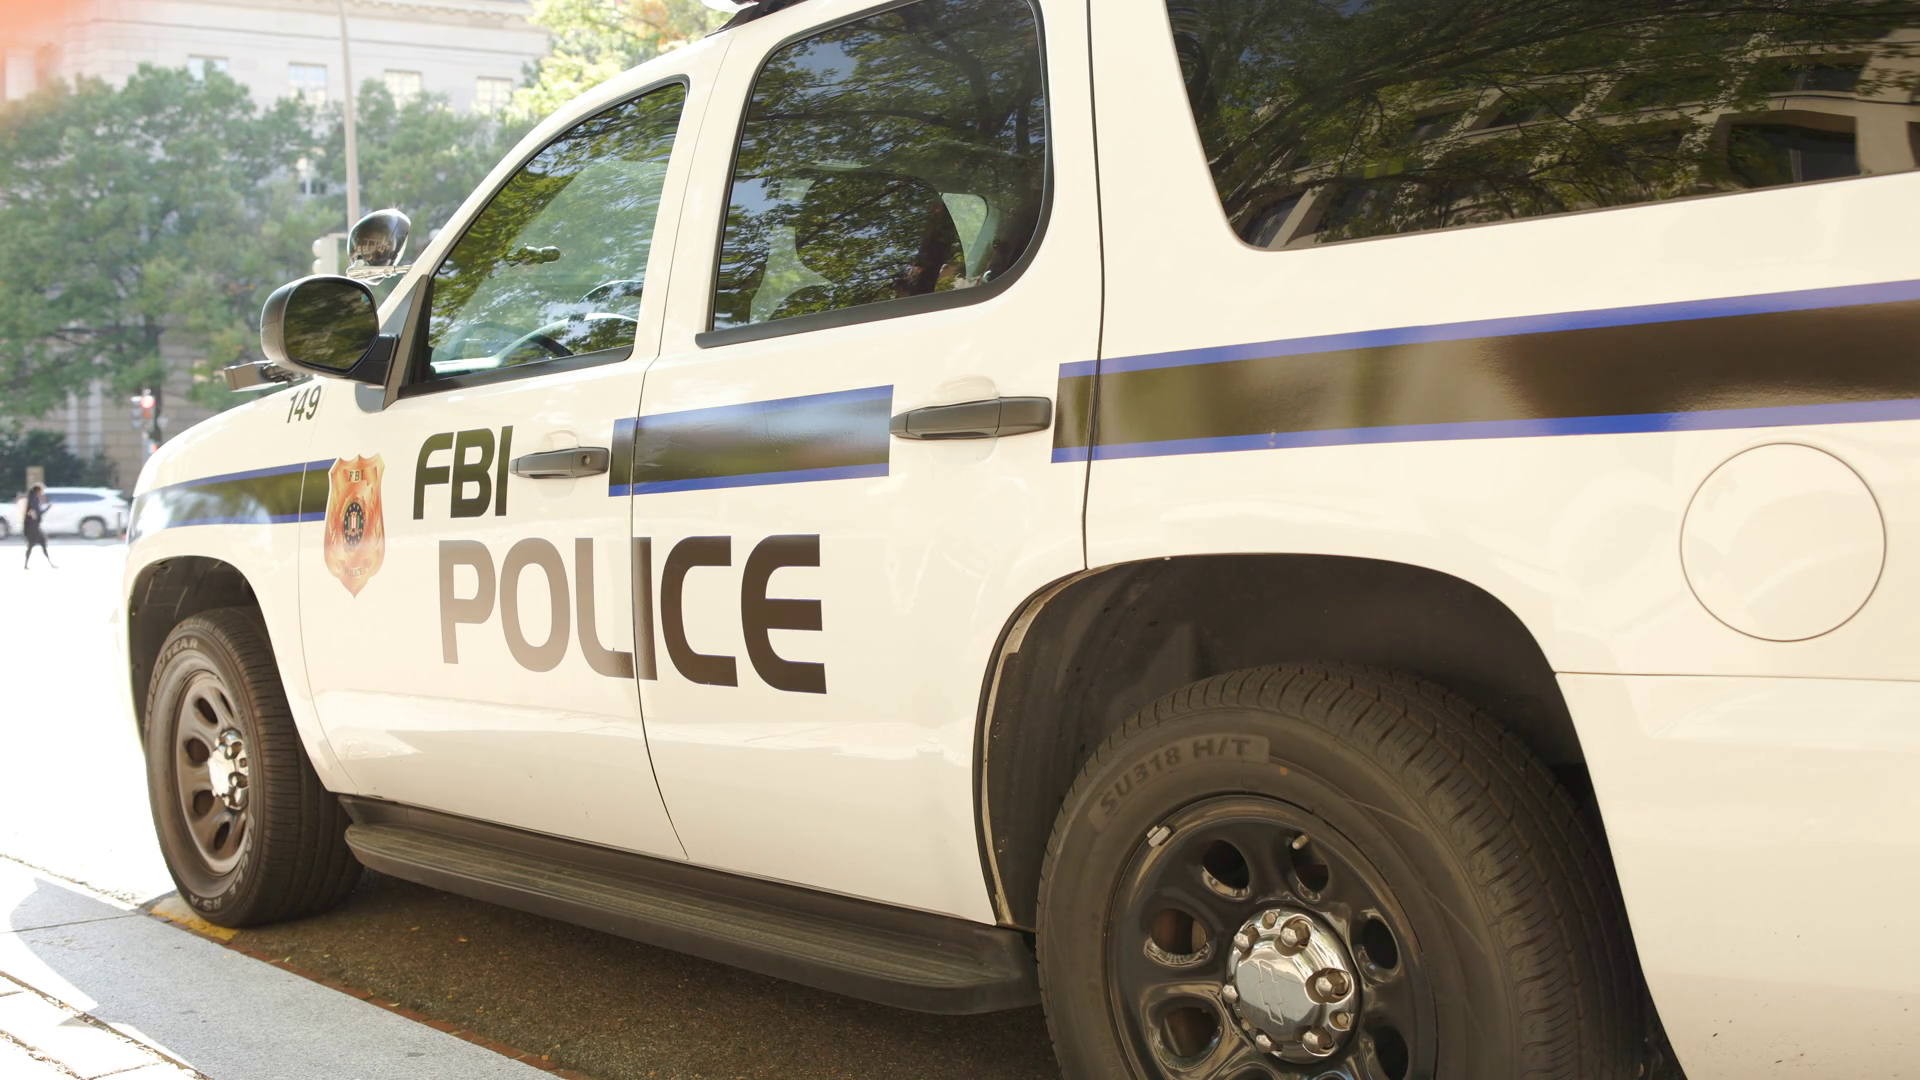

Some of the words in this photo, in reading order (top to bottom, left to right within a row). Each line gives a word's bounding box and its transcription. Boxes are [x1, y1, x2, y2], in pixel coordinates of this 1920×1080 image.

[287, 385, 322, 424] 149
[349, 469, 364, 482] FBI
[413, 425, 513, 520] FBI
[344, 567, 364, 578] POLICE
[438, 534, 827, 694] POLICE
[1100, 747, 1182, 817] SU318
[1192, 736, 1250, 758] H/T
